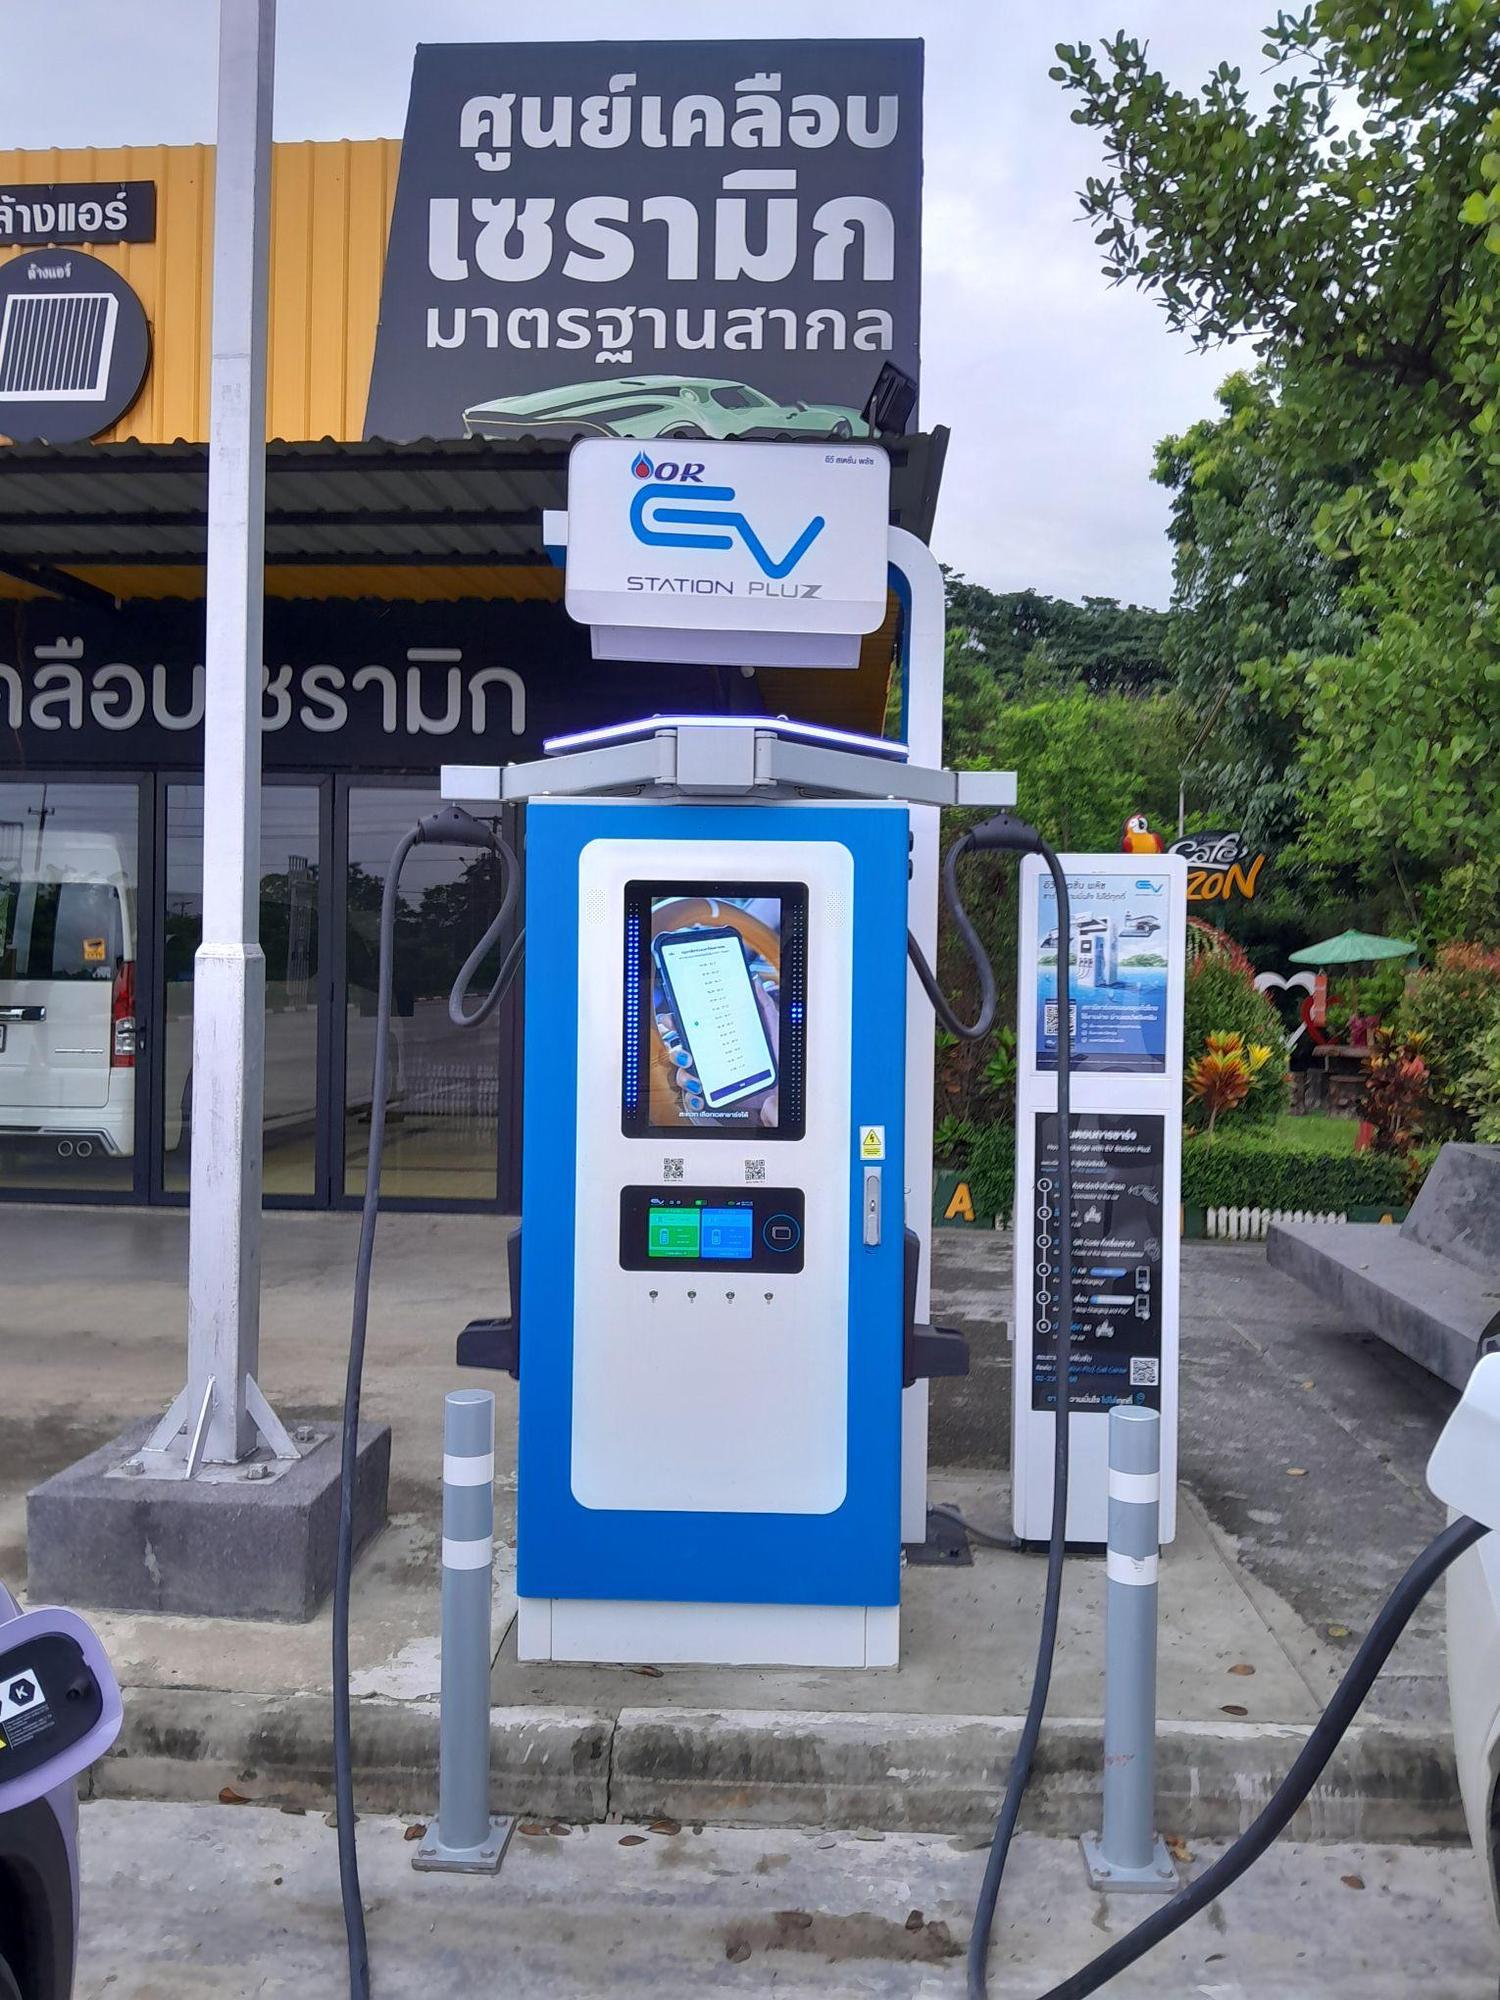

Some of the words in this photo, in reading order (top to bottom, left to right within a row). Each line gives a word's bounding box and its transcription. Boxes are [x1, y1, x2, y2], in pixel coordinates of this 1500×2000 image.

[459, 72, 898, 171] ศูนย์เคลือบ
[428, 169, 895, 282] เซรามิก
[426, 306, 894, 364] มาตรฐานสากล
[654, 462, 706, 482] OR
[629, 483, 825, 579] EV
[627, 577, 734, 594] STATION
[944, 1183, 975, 1222] A
